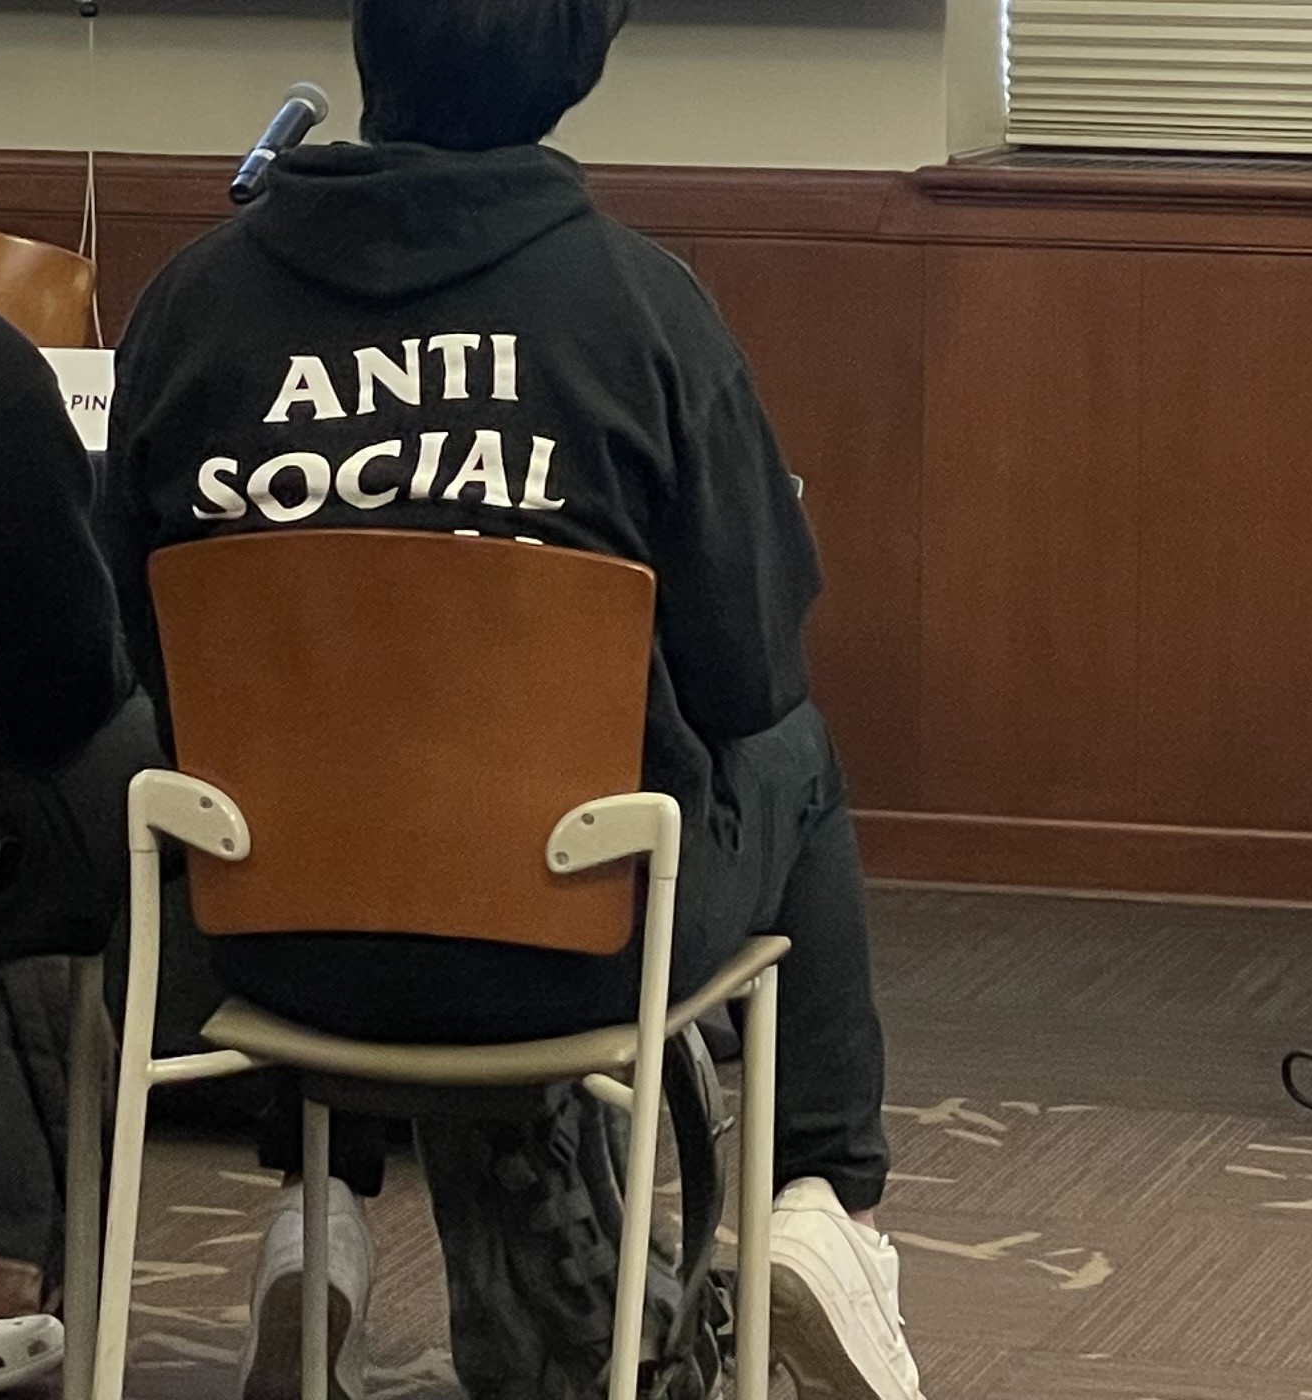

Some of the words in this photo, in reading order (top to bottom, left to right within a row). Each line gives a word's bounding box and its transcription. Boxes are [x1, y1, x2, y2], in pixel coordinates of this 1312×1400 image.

[71, 394, 108, 411] PIN
[263, 333, 519, 423] ANTI
[192, 429, 566, 523] SOCIAL
